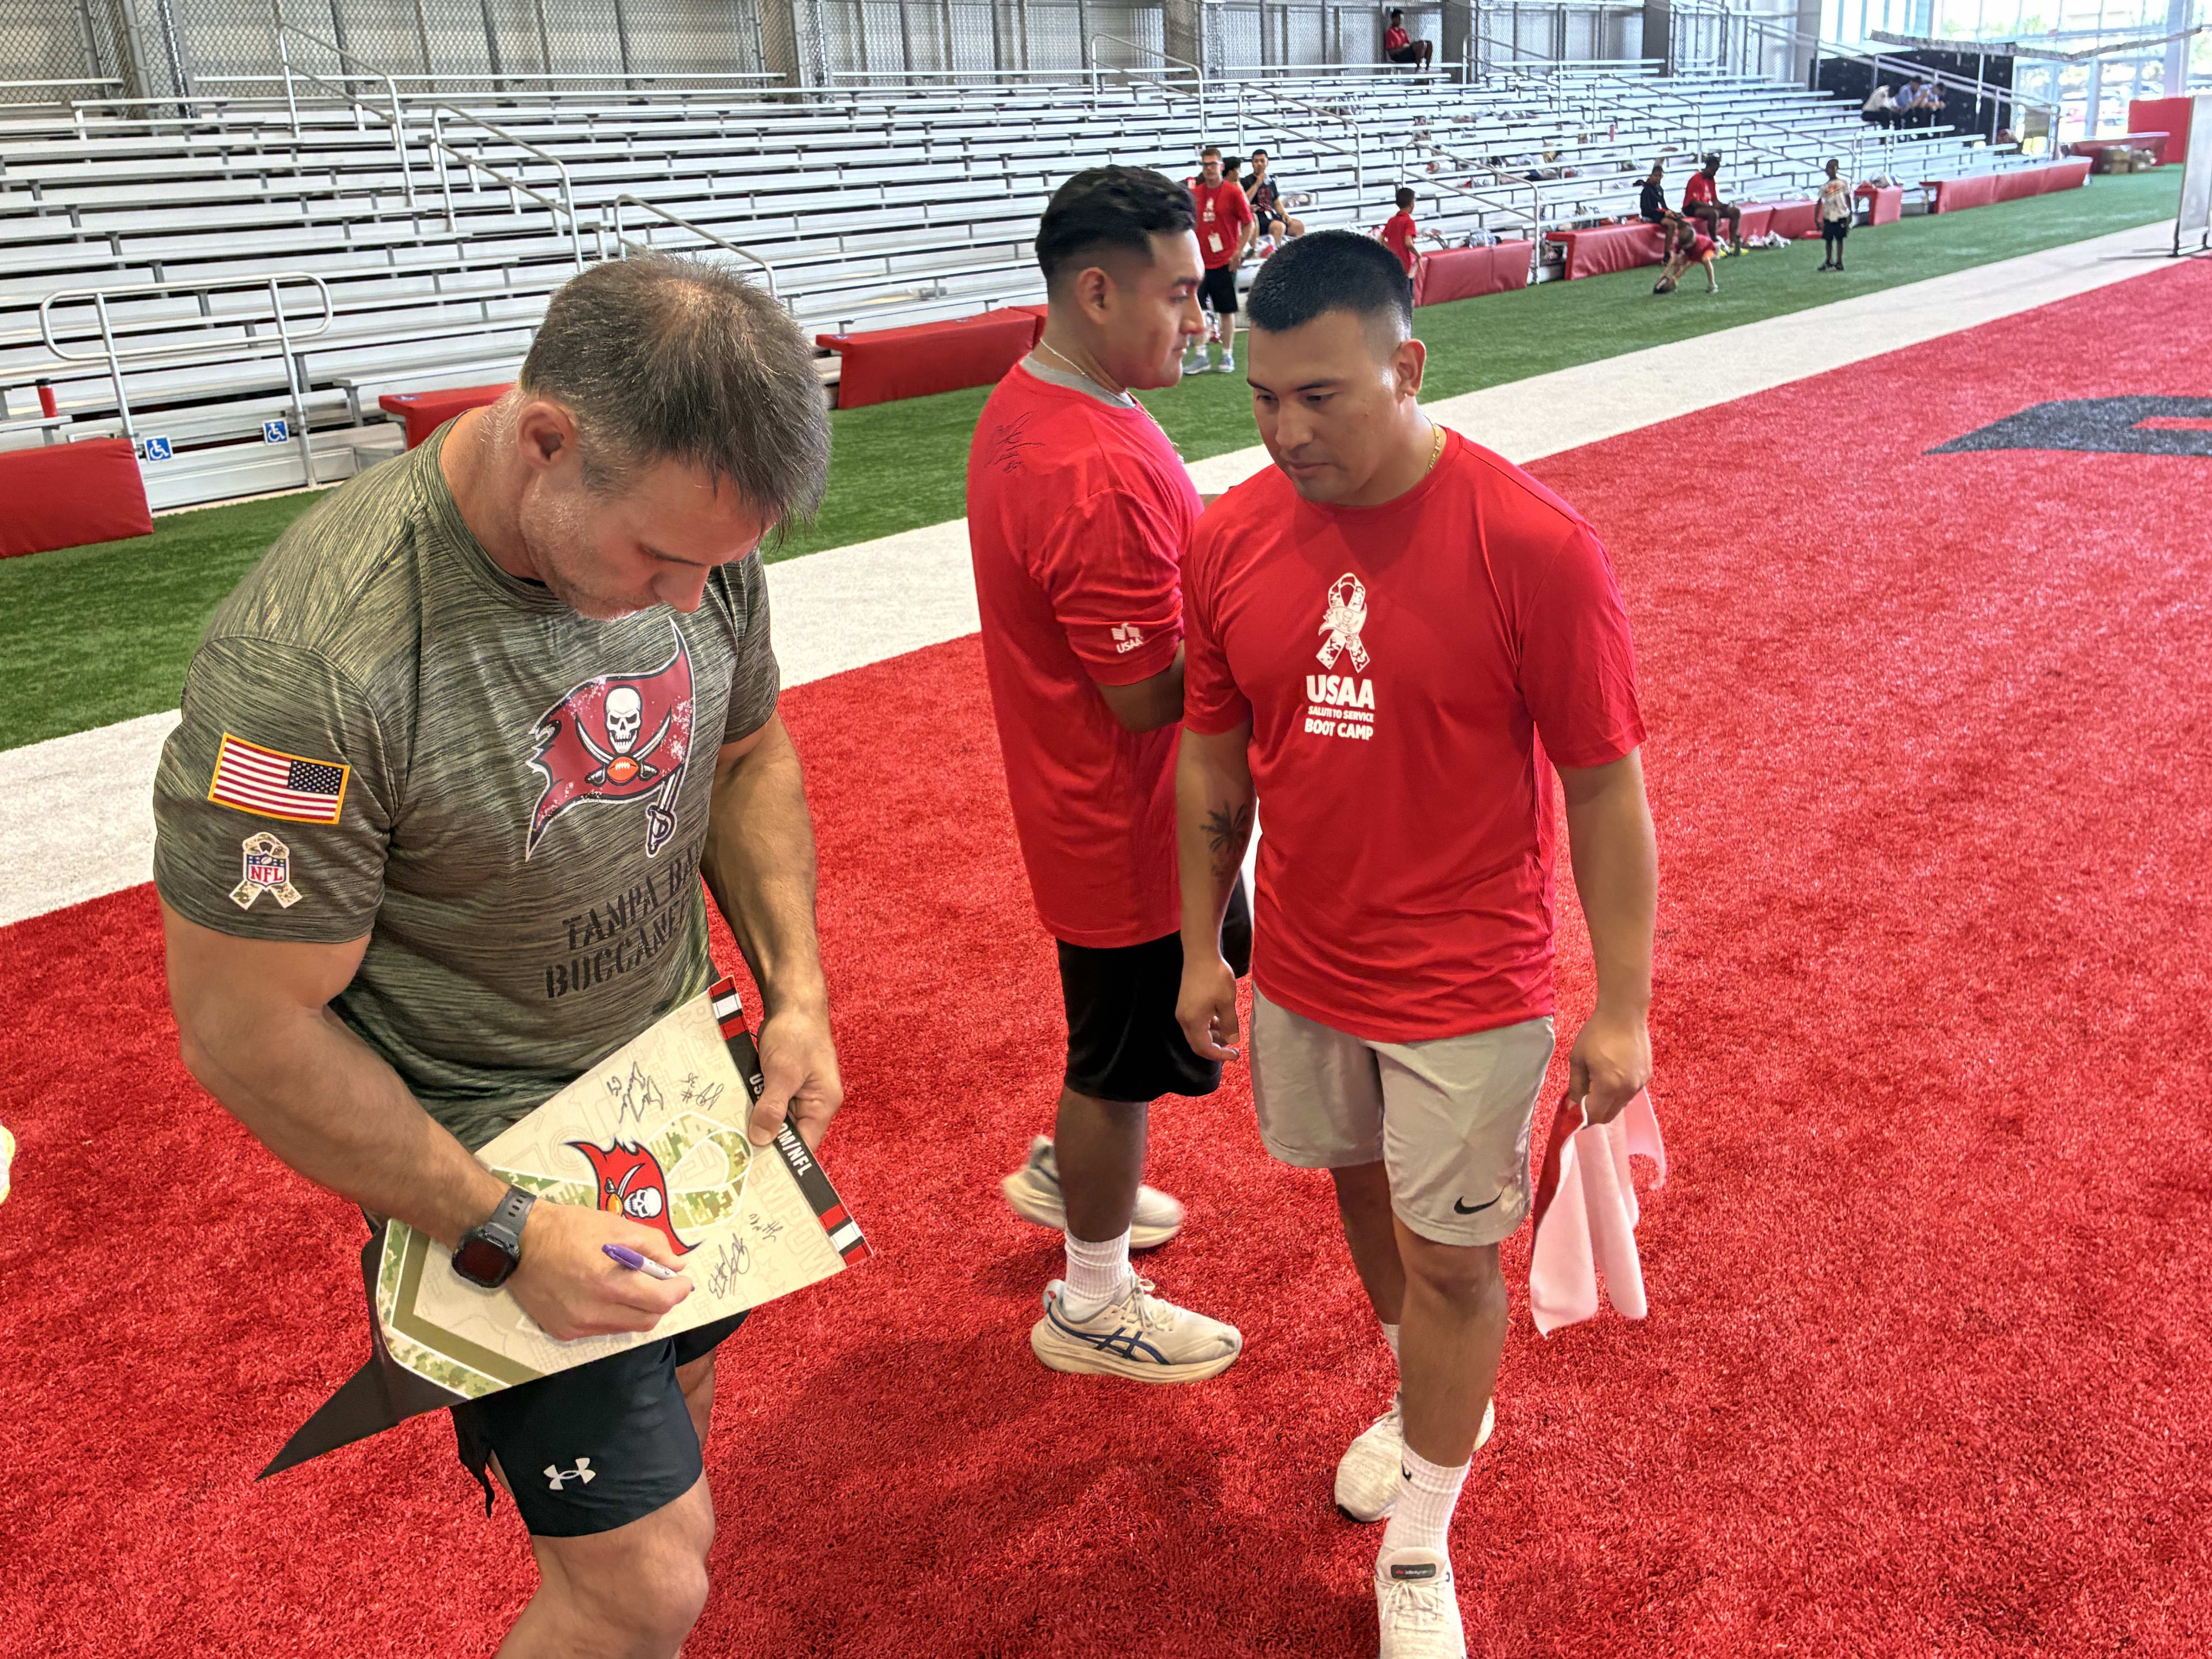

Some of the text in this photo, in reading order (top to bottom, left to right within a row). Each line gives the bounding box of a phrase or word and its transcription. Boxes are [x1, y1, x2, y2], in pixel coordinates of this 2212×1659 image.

[1116, 637, 1143, 653] USAA
[1306, 675, 1375, 710] USAA
[1332, 709, 1342, 719] TO
[1343, 710, 1374, 723] SERVICE
[1304, 718, 1373, 740] BOOT CAMP
[250, 865, 283, 882] NFL
[562, 848, 695, 950] TAMPA BA
